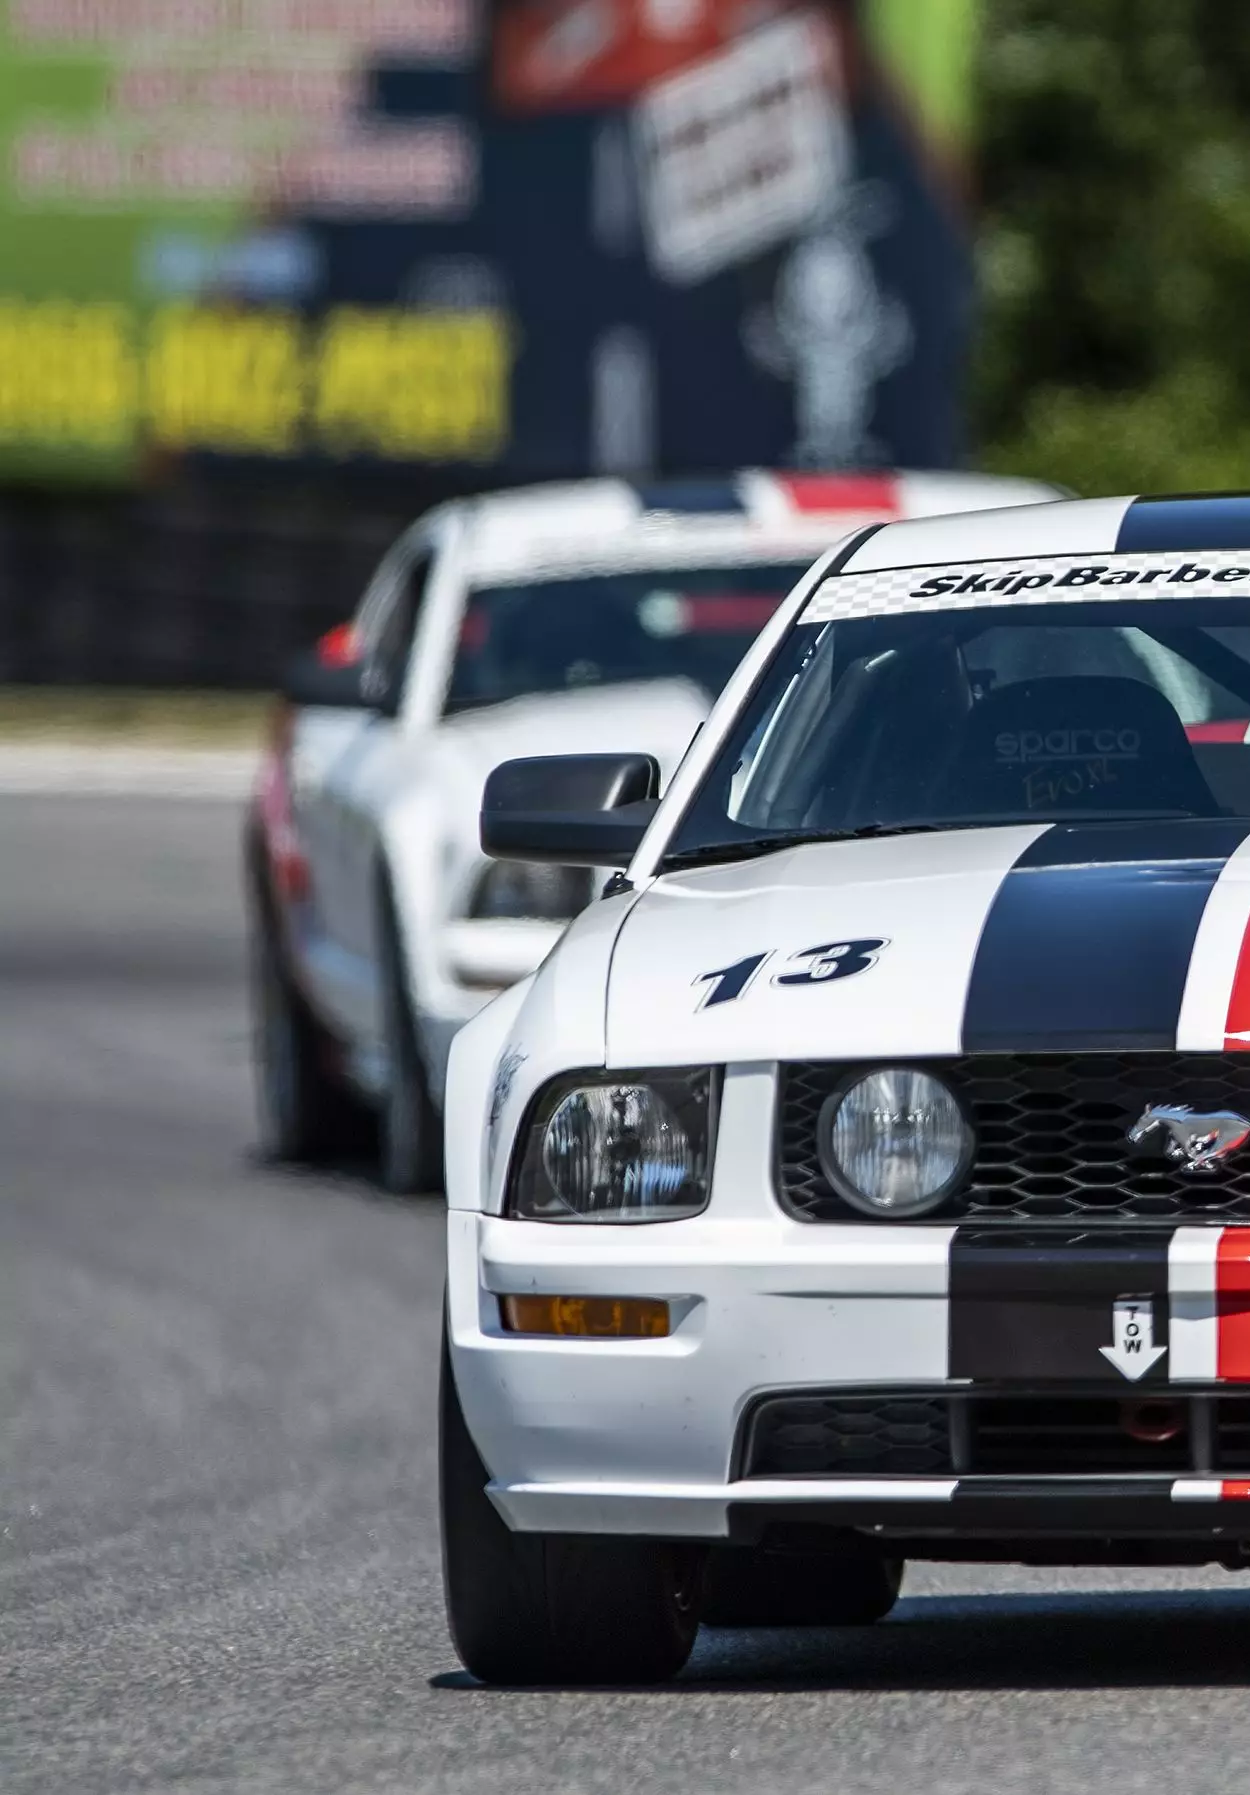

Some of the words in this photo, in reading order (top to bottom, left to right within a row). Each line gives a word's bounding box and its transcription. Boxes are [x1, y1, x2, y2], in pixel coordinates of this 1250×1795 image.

[994, 728, 1142, 763] sparco
[691, 937, 893, 1013] 13
[1124, 1305, 1143, 1354] TOW
